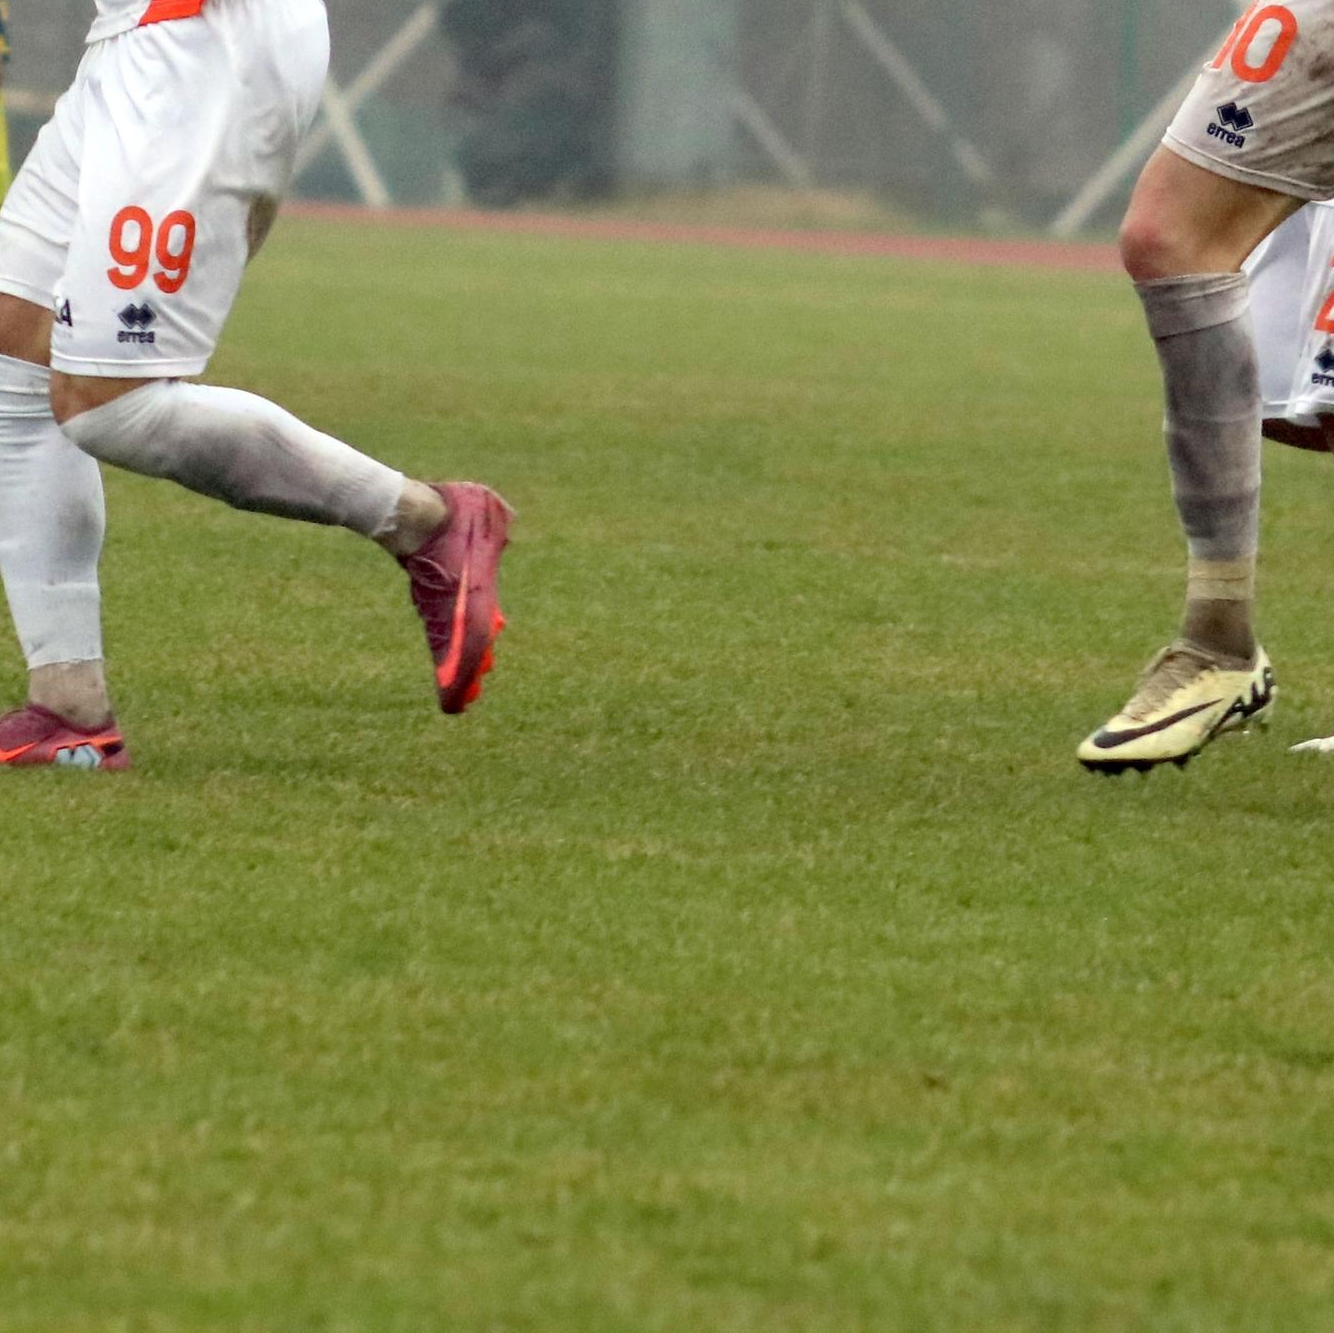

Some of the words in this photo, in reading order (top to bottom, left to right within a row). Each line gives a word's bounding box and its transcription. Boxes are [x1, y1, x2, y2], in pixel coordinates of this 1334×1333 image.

[1207, 122, 1246, 149] errea
[107, 205, 196, 295] 99
[117, 330, 155, 344] errea
